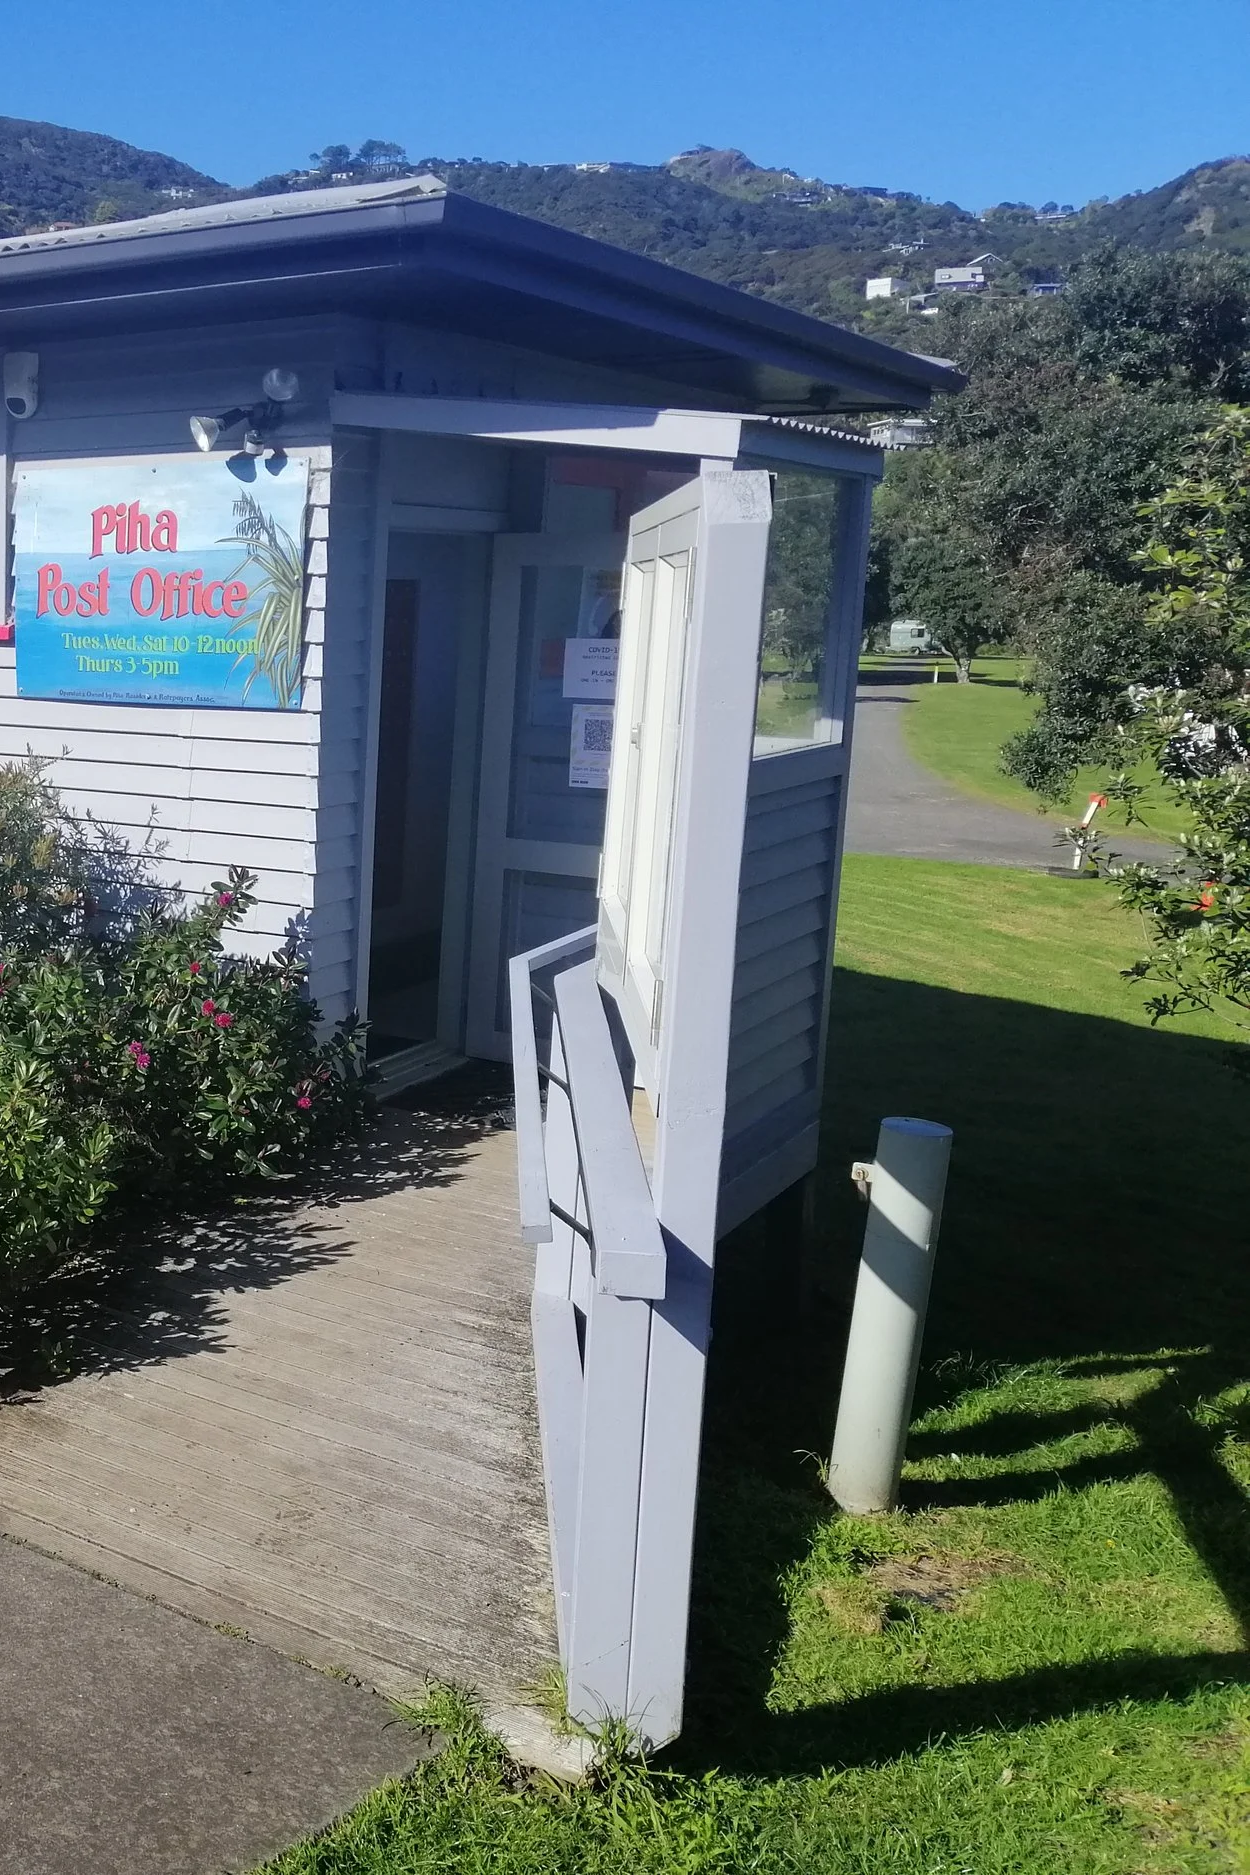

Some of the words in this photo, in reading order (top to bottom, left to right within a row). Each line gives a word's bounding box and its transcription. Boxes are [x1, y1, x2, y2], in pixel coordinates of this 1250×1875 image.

[89, 500, 178, 559] Piha
[36, 563, 110, 618] Post
[131, 567, 248, 621] Office
[588, 646, 618, 654] COVID-1
[76, 655, 122, 673] Thurs
[126, 657, 179, 679] 3-5pm
[159, 693, 193, 703] Ratepayers
